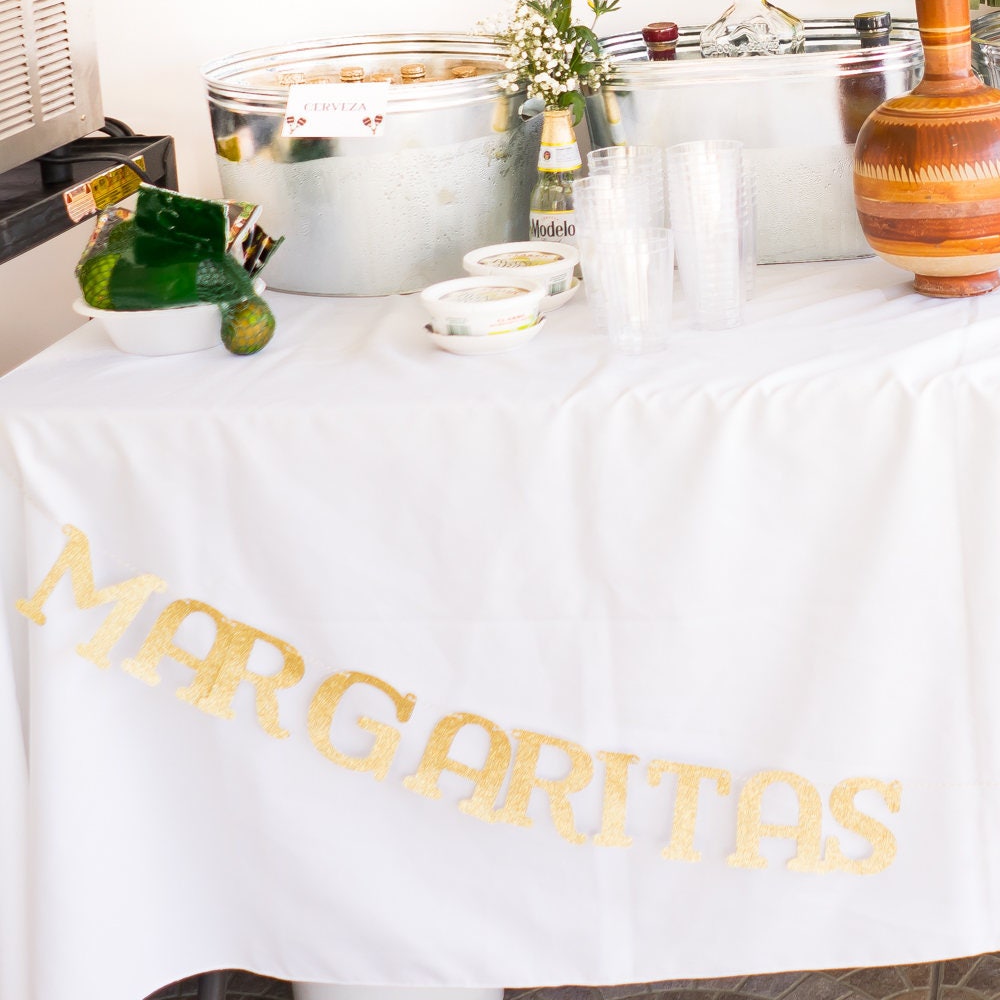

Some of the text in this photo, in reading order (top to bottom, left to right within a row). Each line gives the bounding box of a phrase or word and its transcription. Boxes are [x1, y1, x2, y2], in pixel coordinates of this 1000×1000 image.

[303, 102, 367, 112] CERVEZA
[531, 218, 576, 238] Modelo
[14, 523, 903, 876] MARGARITAS
